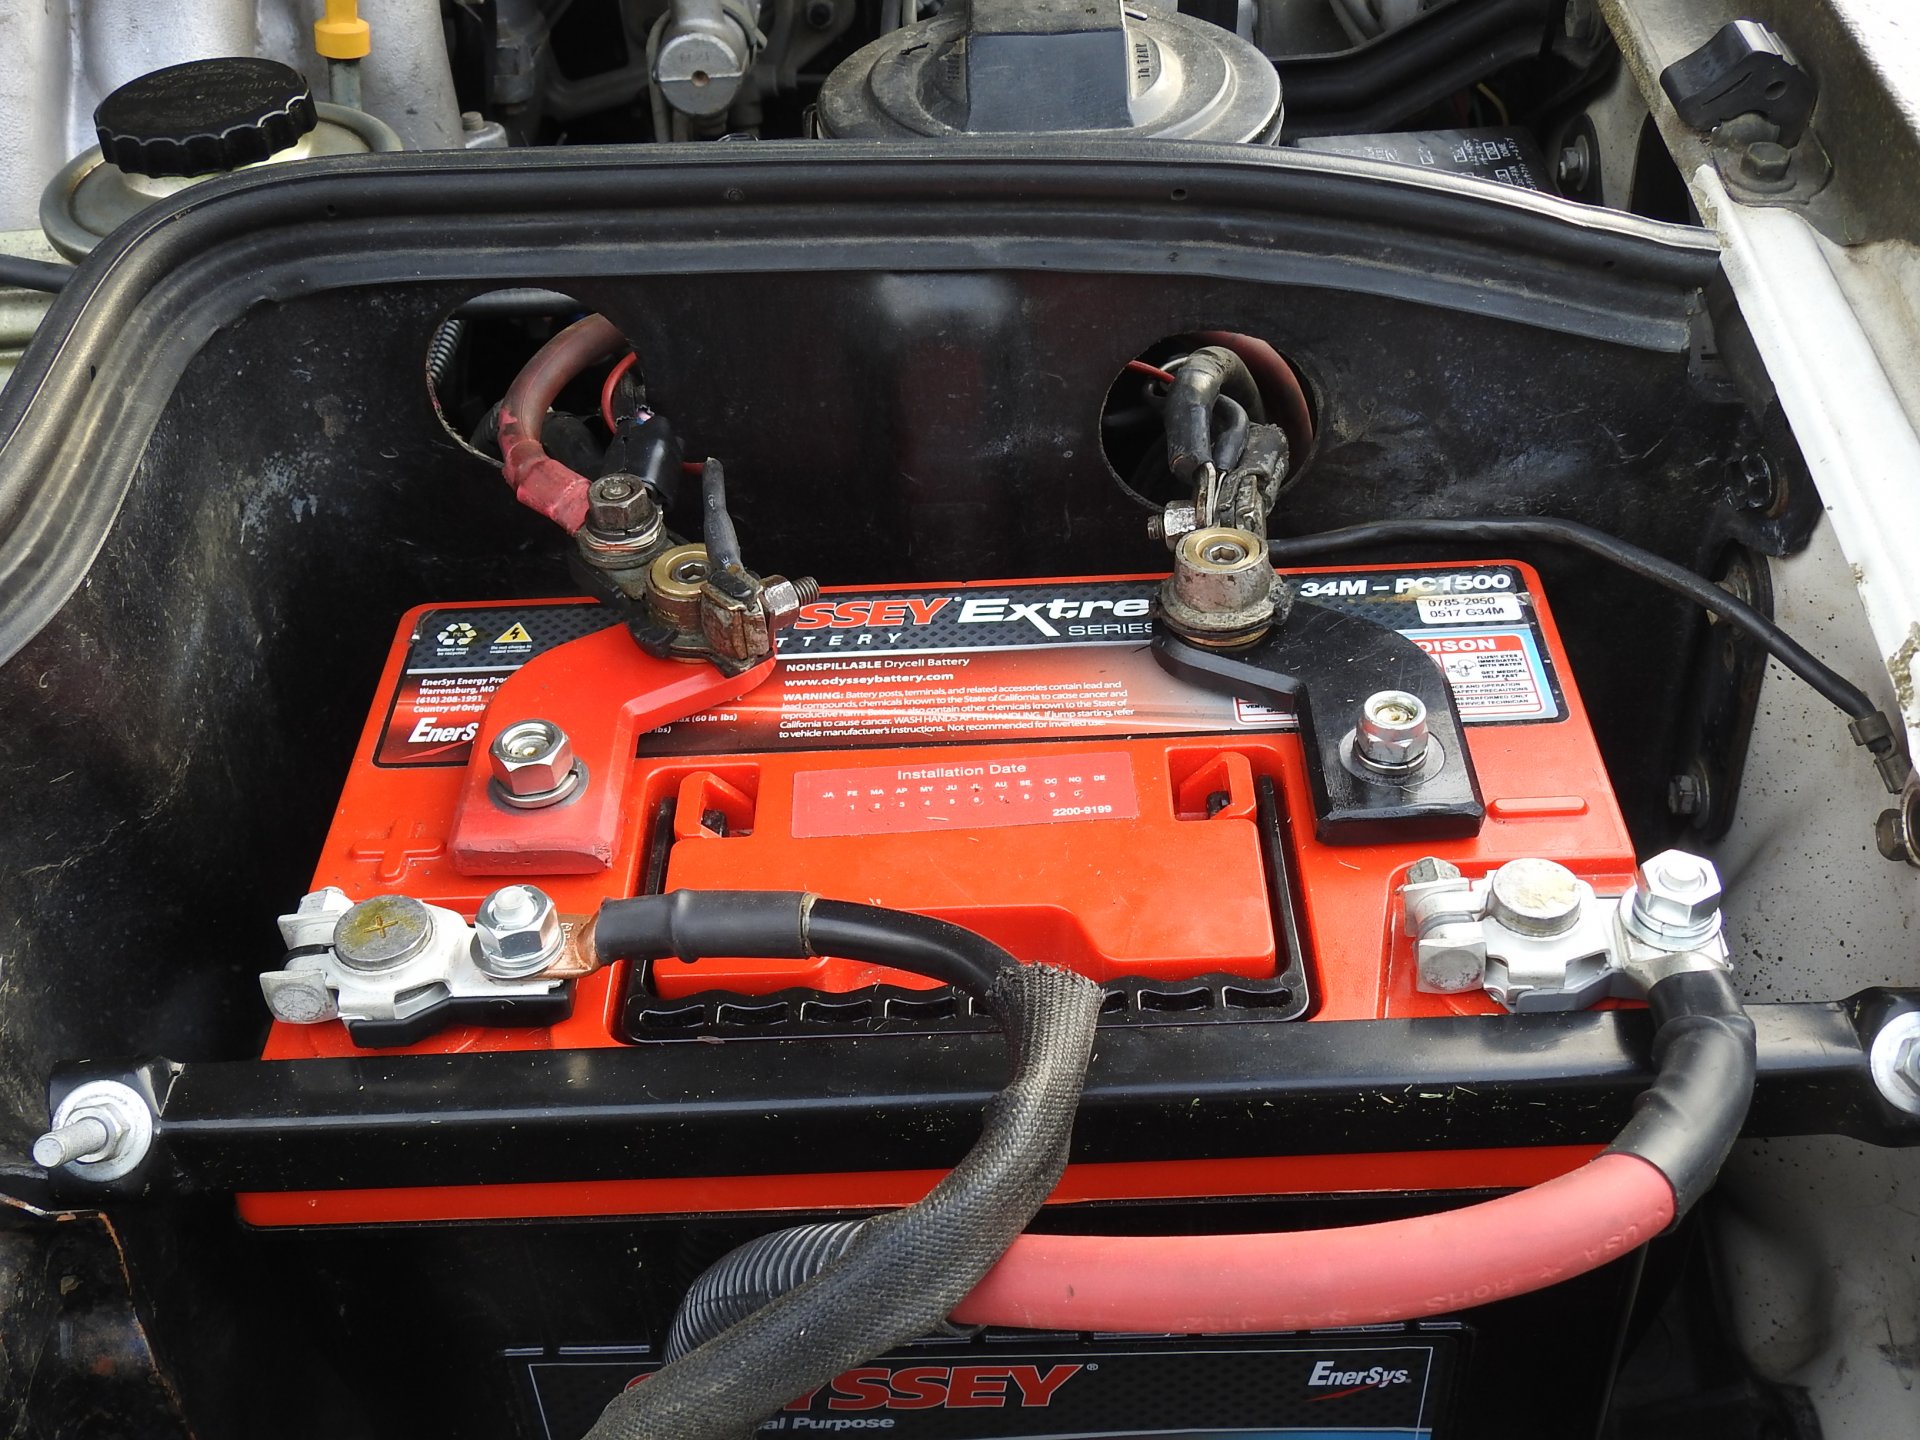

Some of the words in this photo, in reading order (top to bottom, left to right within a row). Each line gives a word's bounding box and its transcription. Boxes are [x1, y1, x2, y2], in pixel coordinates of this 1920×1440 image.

[1300, 580, 1367, 597] 34M
[1395, 574, 1511, 594] PC1500
[793, 598, 952, 629] SSEY
[958, 598, 1149, 637] Extre
[1430, 608, 1461, 618] 0517
[1466, 606, 1505, 616] G34M
[1068, 622, 1152, 635] SERIES
[776, 632, 902, 648] TTERY
[1420, 638, 1497, 652] OISON
[884, 658, 925, 669] Drycell
[928, 658, 970, 668] Battery
[421, 679, 456, 687] EnerSys
[457, 678, 488, 686] Energy
[489, 676, 509, 684] Pro
[784, 673, 954, 687] www.odysseybattery.com
[419, 686, 478, 695] Warrensburg,
[480, 685, 495, 693] MO
[783, 692, 844, 701] WARNING:
[846, 691, 878, 700] Battery
[998, 684, 1048, 692] accessories
[1049, 682, 1082, 691] contain
[1104, 681, 1122, 689] and
[415, 696, 440, 704] (610)
[440, 695, 482, 703] 208-1991
[858, 699, 902, 707] chemicals
[988, 694, 998, 702] of
[999, 693, 1040, 701] California
[1079, 691, 1109, 699] cancer
[1110, 689, 1128, 697] and
[413, 705, 450, 713] Country
[450, 704, 461, 712] of
[926, 705, 959, 713] contain
[961, 704, 986, 712] other
[986, 703, 1031, 711] chemicals
[1032, 702, 1064, 710] known
[1093, 699, 1116, 707] State
[692, 715, 706, 723] (60
[720, 713, 737, 722] lbs)
[780, 720, 822, 729] California
[834, 719, 860, 727] cause
[894, 716, 922, 724] WASH
[923, 715, 957, 723] HANDS
[1114, 708, 1135, 716] refer
[407, 717, 479, 743] EnerS
[790, 729, 821, 738] vehicle
[890, 725, 944, 734] instructions.
[947, 724, 965, 732] Not
[966, 722, 1034, 731] recommended
[1035, 720, 1049, 728] for
[1049, 719, 1087, 728] inverted
[897, 767, 984, 780] Installation
[989, 764, 1026, 775] Date
[1052, 805, 1112, 816] 2200-9199
[1308, 1361, 1409, 1387] EnerSys
[785, 1365, 1084, 1411] SSEY
[792, 1416, 895, 1433] Purpose
